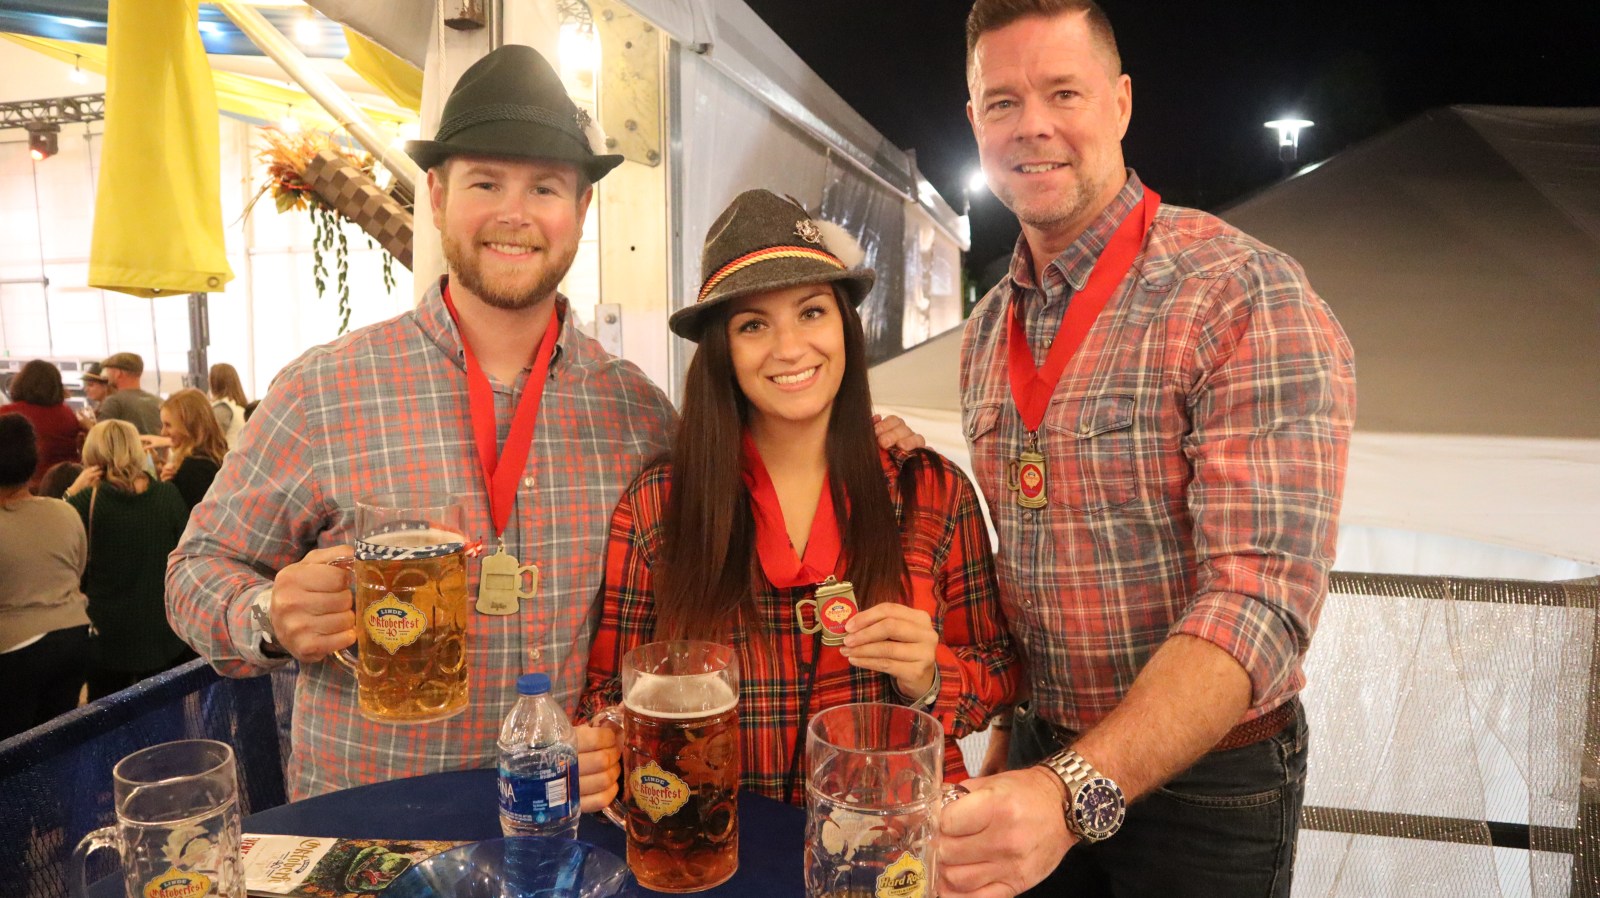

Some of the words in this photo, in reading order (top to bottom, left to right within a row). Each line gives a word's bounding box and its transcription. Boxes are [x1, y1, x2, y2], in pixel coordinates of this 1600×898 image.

[368, 614, 420, 630] Oktoberfest
[386, 628, 397, 637] 40
[643, 776, 666, 785] LINDE
[633, 780, 682, 799] Oktoberfest
[649, 796, 660, 806] 40
[880, 875, 906, 888] Hard
